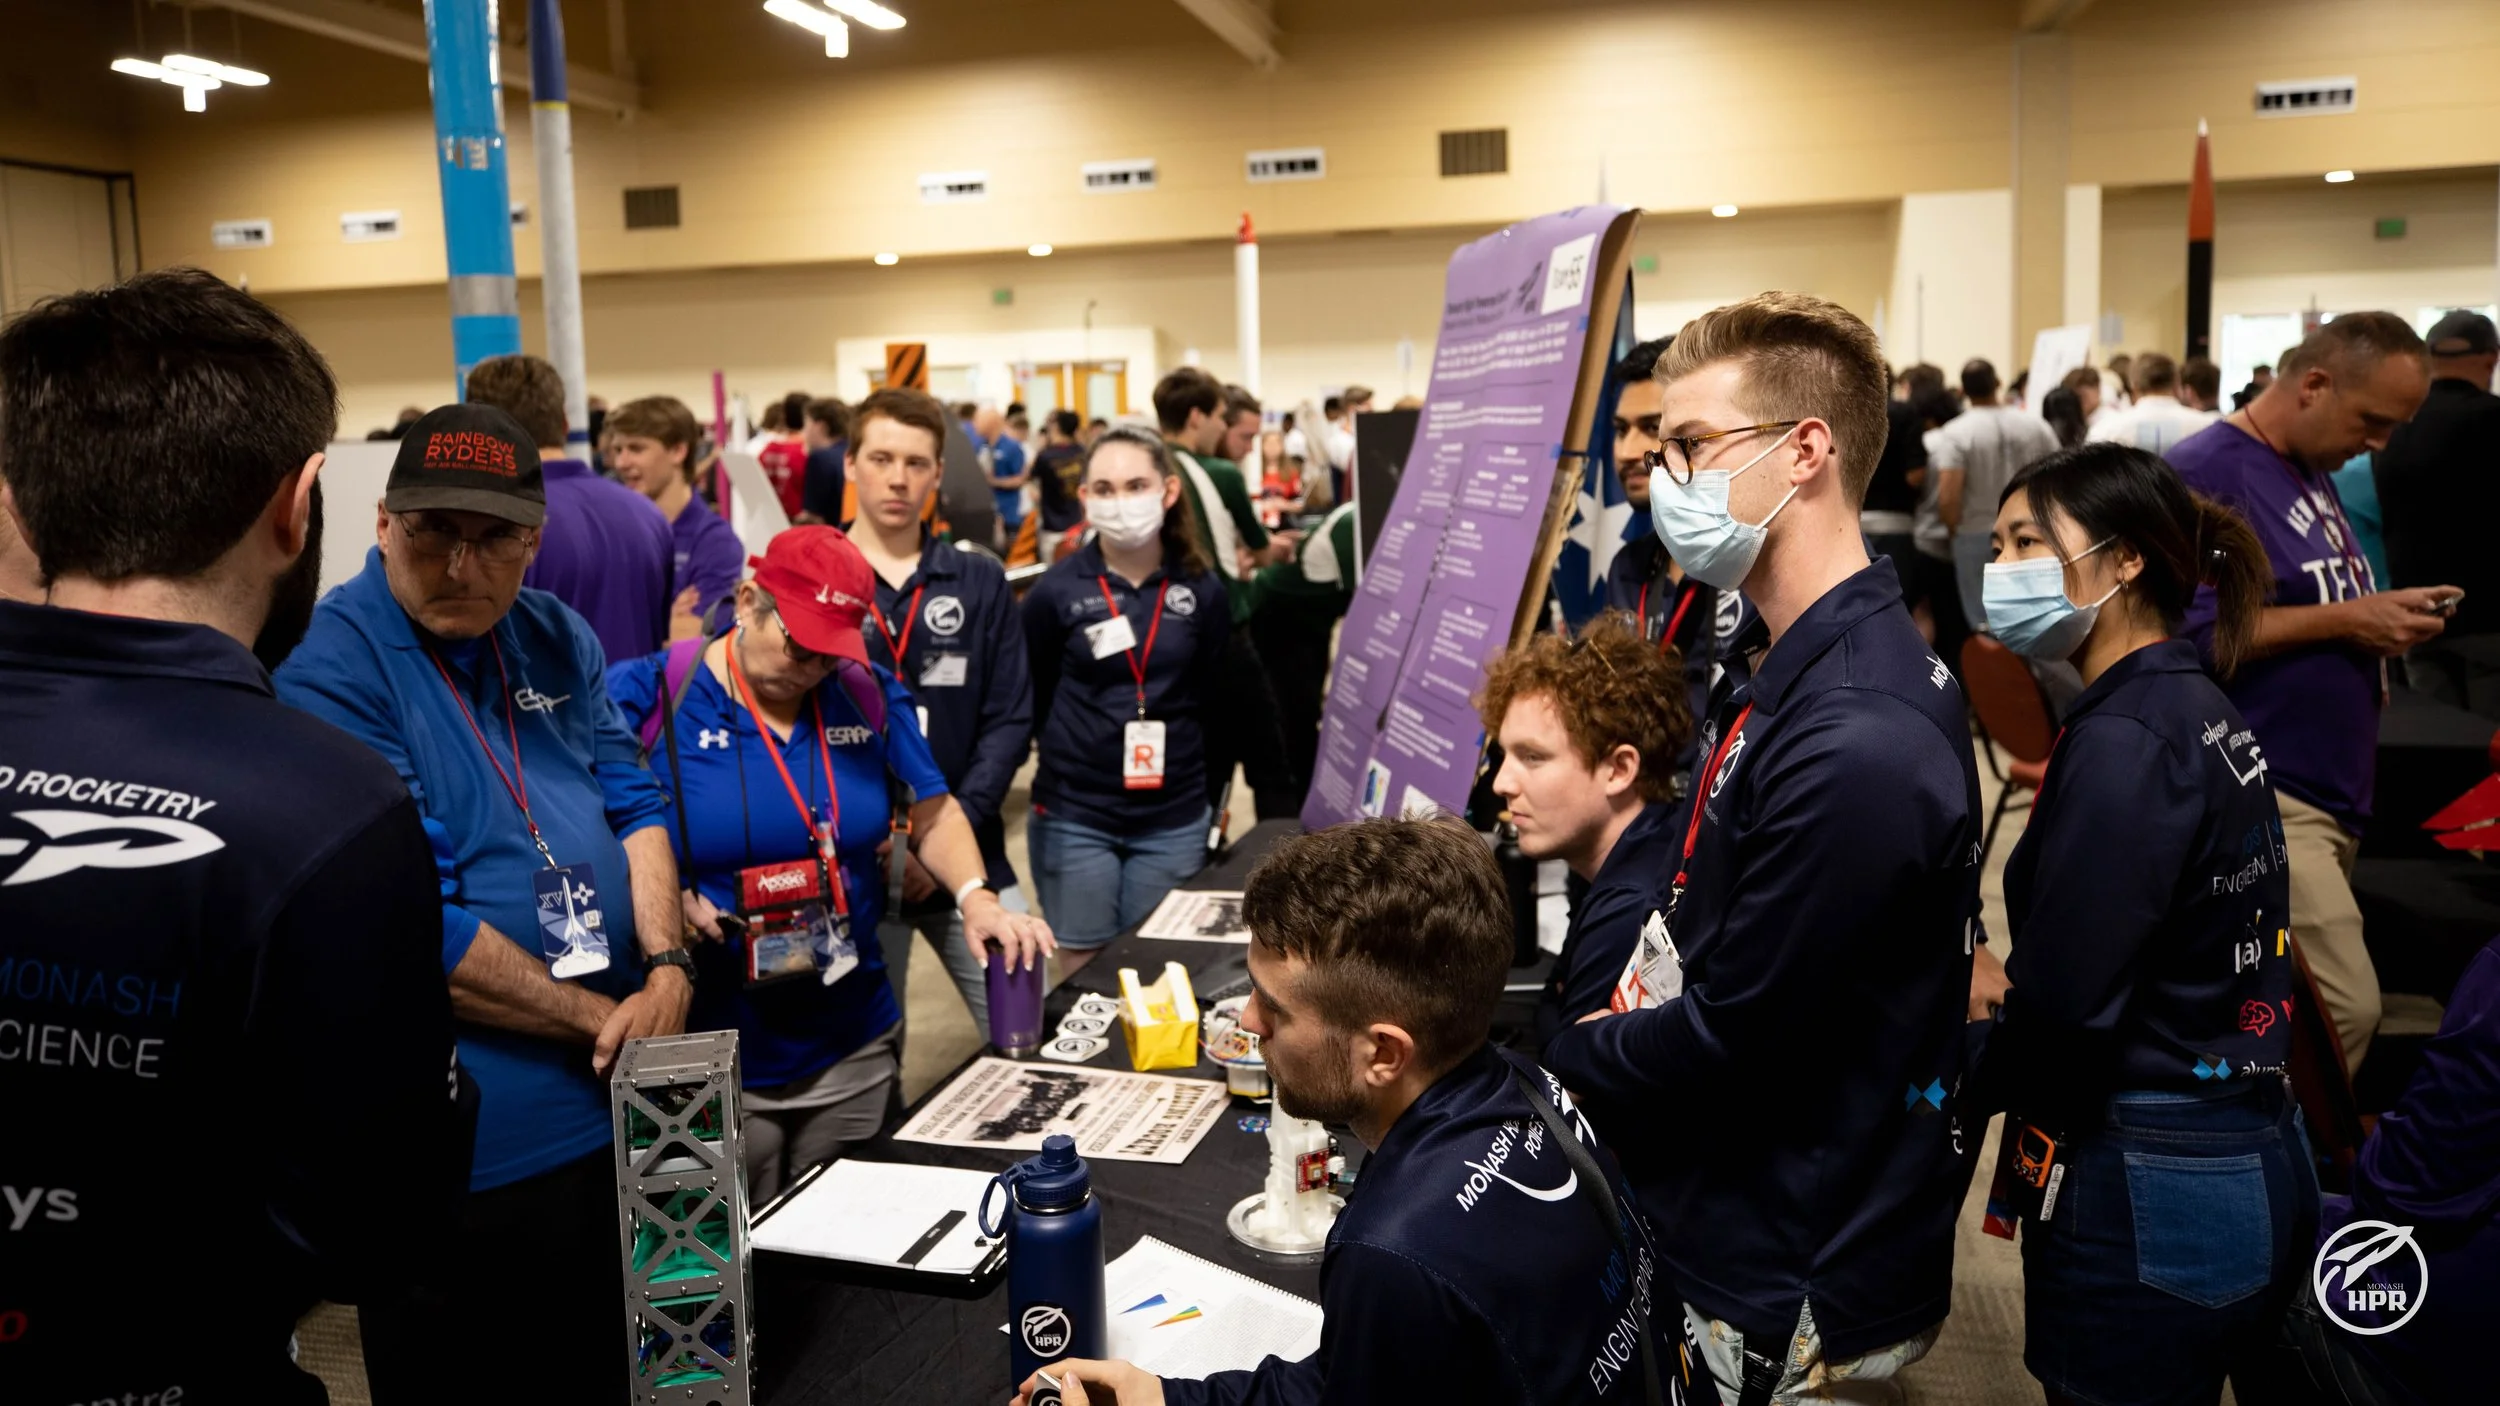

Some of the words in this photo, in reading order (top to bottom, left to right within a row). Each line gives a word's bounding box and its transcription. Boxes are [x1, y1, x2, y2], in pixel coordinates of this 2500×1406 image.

[429, 432, 516, 454] RAINBOW
[425, 445, 517, 470] RYDERS
[1134, 745, 1155, 770] R
[16, 770, 218, 820] ROCKETRY
[539, 891, 563, 909] XV
[1117, 1123, 1177, 1155] ROCKET
[1455, 1129, 1513, 1212] MONASH
[1034, 1336, 1062, 1347] HPR
